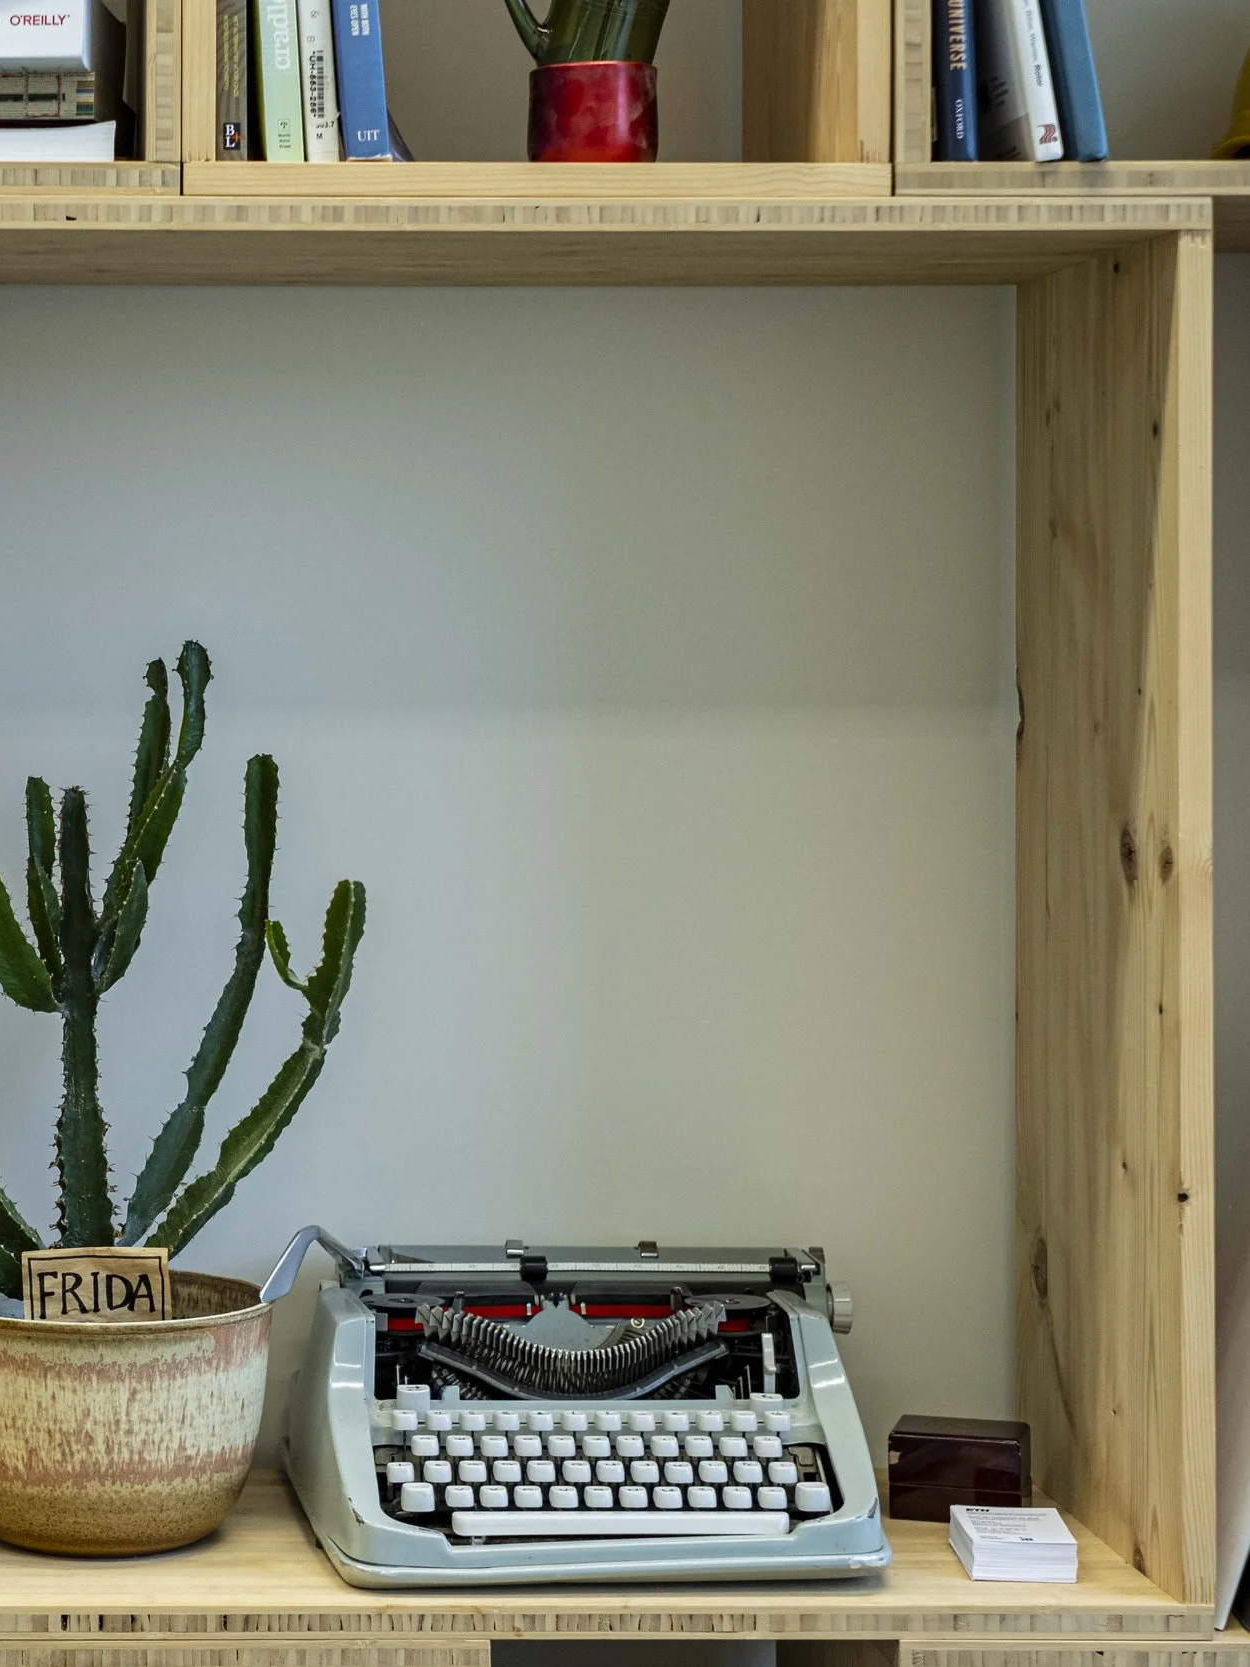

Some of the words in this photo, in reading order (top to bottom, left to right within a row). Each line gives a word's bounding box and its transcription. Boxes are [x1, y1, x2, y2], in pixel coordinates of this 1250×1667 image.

[225, 124, 235, 136] B
[955, 99, 965, 140] OXFORD
[357, 129, 380, 142] UIT
[37, 1271, 156, 1319] FRIDA
